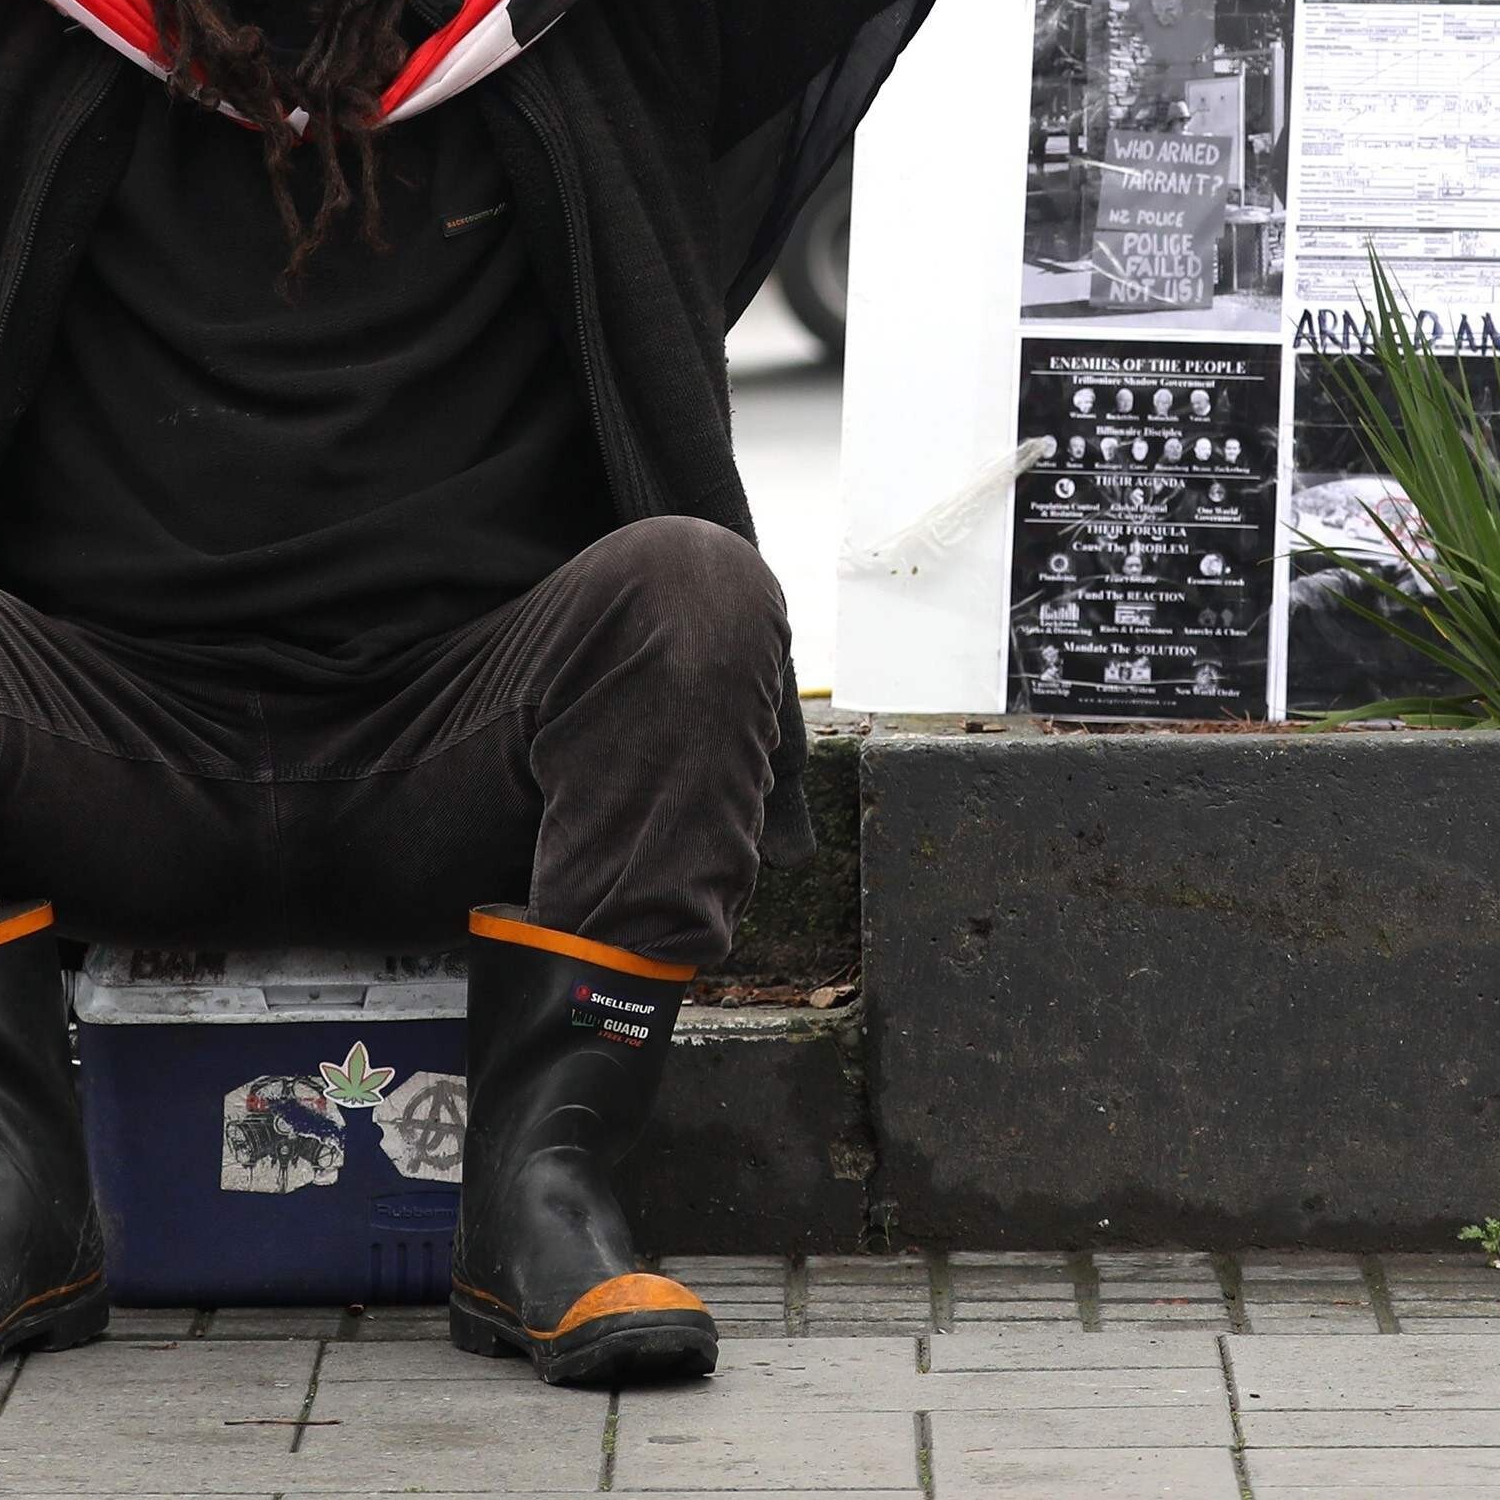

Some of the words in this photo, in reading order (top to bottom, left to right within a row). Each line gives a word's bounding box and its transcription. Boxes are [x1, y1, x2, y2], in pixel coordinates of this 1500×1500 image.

[1113, 137, 1154, 160] WHO
[1156, 140, 1220, 166] ARMED
[1109, 208, 1131, 225] NZ
[1136, 210, 1185, 228] POLICE
[1122, 232, 1194, 256] POLICE
[1126, 255, 1202, 278] FAILED
[1109, 278, 1156, 303] NOT
[1164, 278, 1204, 303] US!
[1293, 308, 1444, 356] ARMD
[1049, 356, 1120, 371] ENEMIES
[1123, 357, 1144, 372] OF
[1149, 359, 1181, 373] THE
[1185, 360, 1247, 374] PEOPLE
[1160, 377, 1216, 389] Government
[1095, 475, 1133, 487] THEIR
[1135, 476, 1186, 489] AGENDA
[1086, 523, 1125, 536] THEIR
[1125, 525, 1188, 538] FORMULA
[1129, 543, 1190, 555] PROBLEM
[1105, 589, 1125, 601] The
[1126, 590, 1186, 602] REACTION
[1063, 641, 1109, 654] Mandate
[1111, 642, 1130, 654] The
[1135, 644, 1199, 657] SOLUTION
[590, 992, 656, 1015] SKELLERUP
[603, 1018, 650, 1040] GUARD
